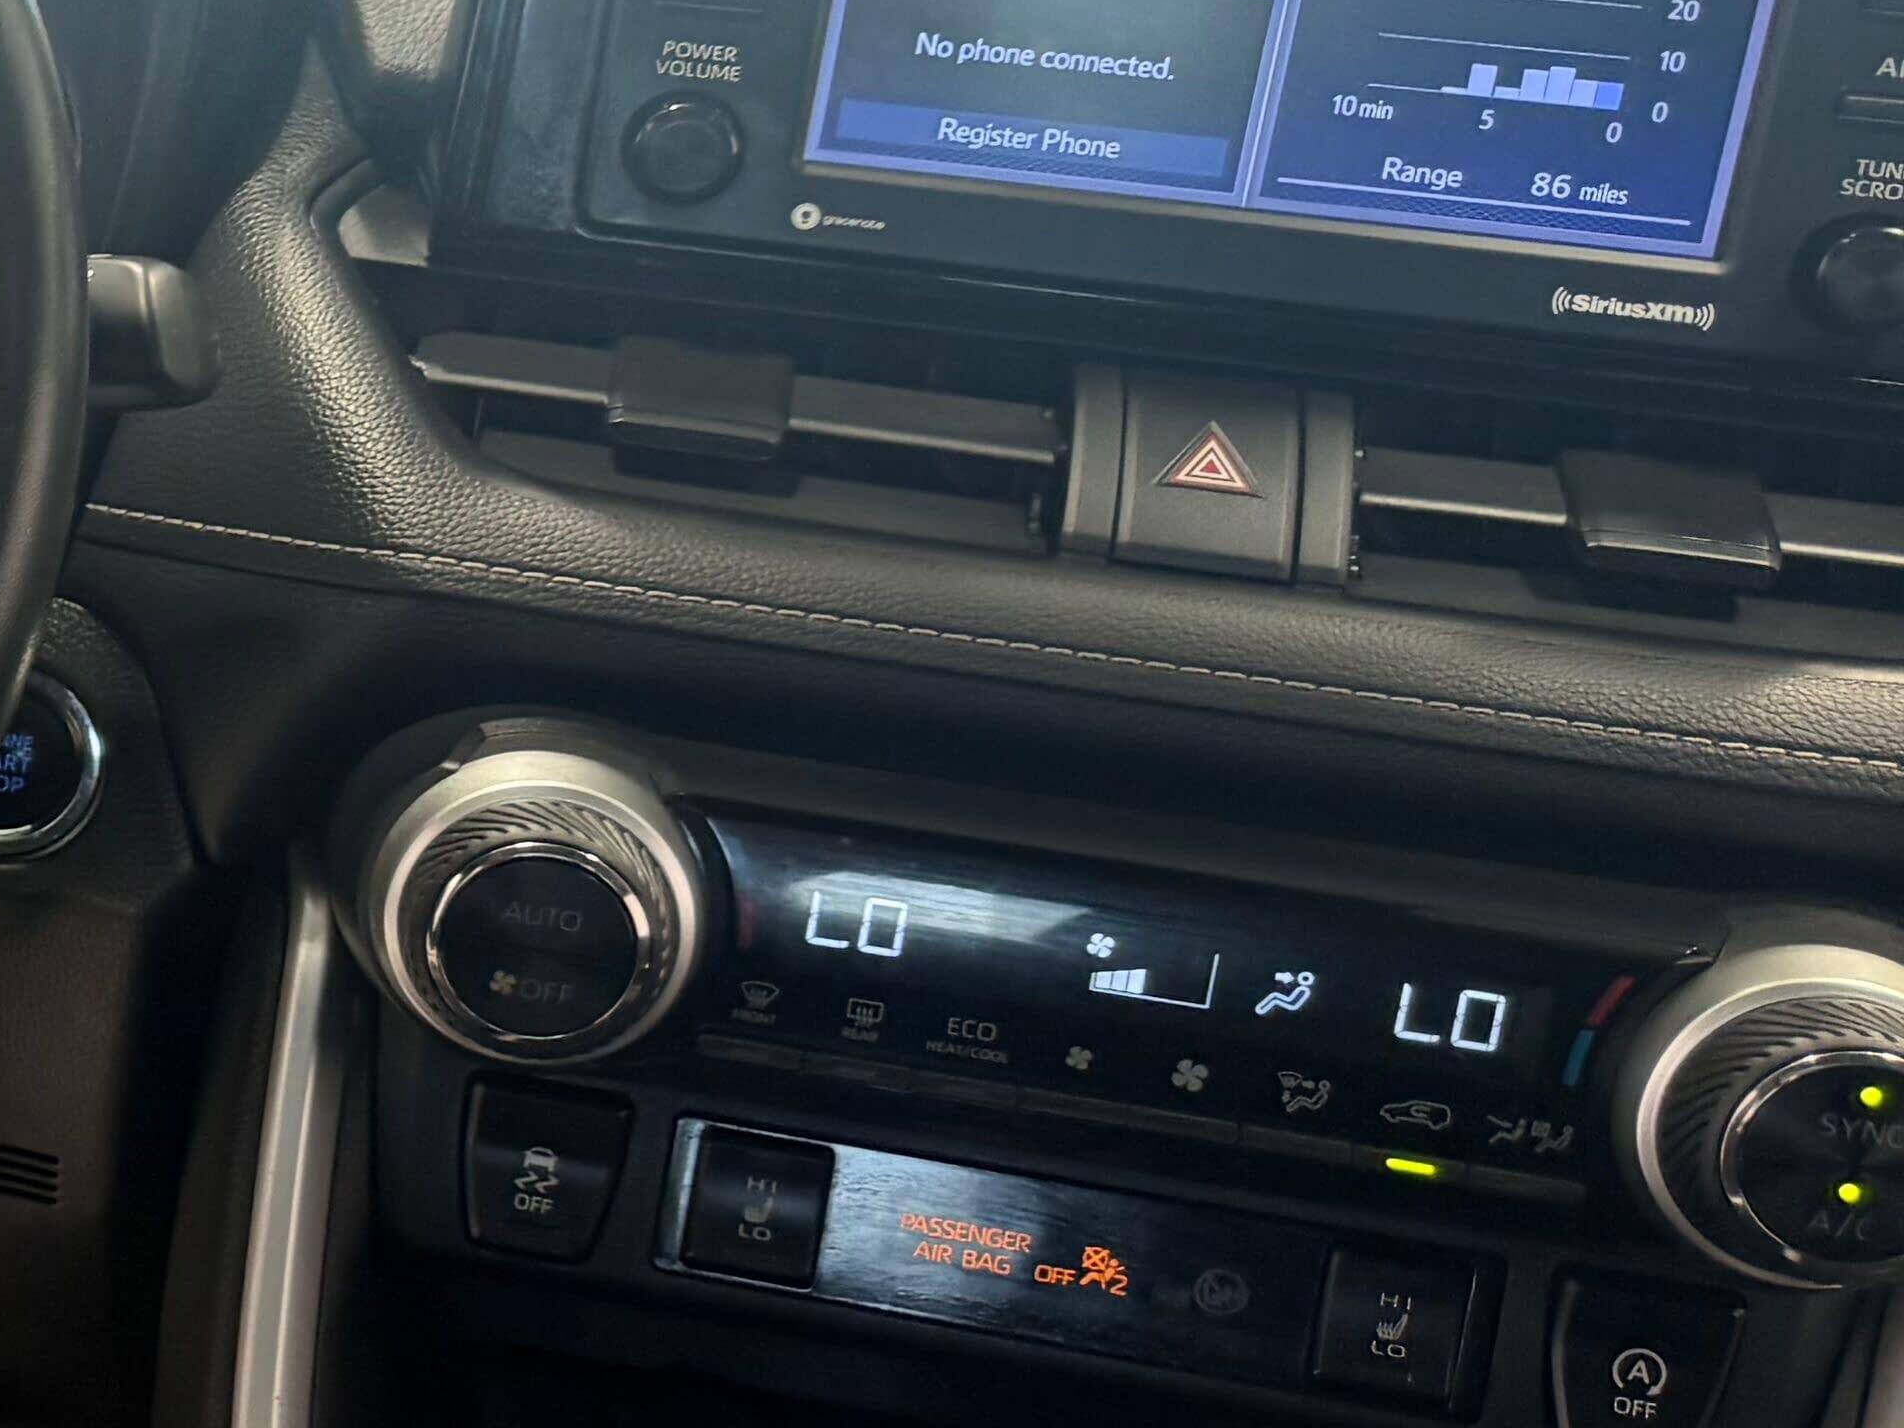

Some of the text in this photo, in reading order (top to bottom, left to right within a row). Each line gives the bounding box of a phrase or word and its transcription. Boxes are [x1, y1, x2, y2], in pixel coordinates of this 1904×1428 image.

[1668, 0, 1700, 22] 20
[662, 40, 737, 62] POWER
[915, 32, 1175, 81] No phone connected.
[1660, 51, 1686, 72] 10
[656, 60, 742, 83] VOLUME
[1331, 94, 1393, 121] 10 min
[1652, 101, 1669, 124] 0
[1479, 110, 1494, 131] 5
[937, 117, 1121, 159] Register Phone
[1606, 121, 1623, 144] 0
[1856, 158, 1904, 179] TUN
[1382, 156, 1629, 205] Range 86 miles
[1840, 179, 1904, 201] SCRO
[503, 901, 582, 932] AUTO
[804, 891, 909, 958] LO
[519, 978, 576, 1003] OFF
[1393, 983, 1507, 1052] LO
[947, 1017, 998, 1042] ECO
[514, 1192, 555, 1214] OFF
[738, 1223, 773, 1242] LO
[901, 1212, 1032, 1253] PASSENGER
[913, 1241, 1011, 1276] AIR BAG
[1034, 1264, 1077, 1286] OFF
[1371, 1340, 1405, 1358] LO
[1614, 1396, 1657, 1419] OFF
